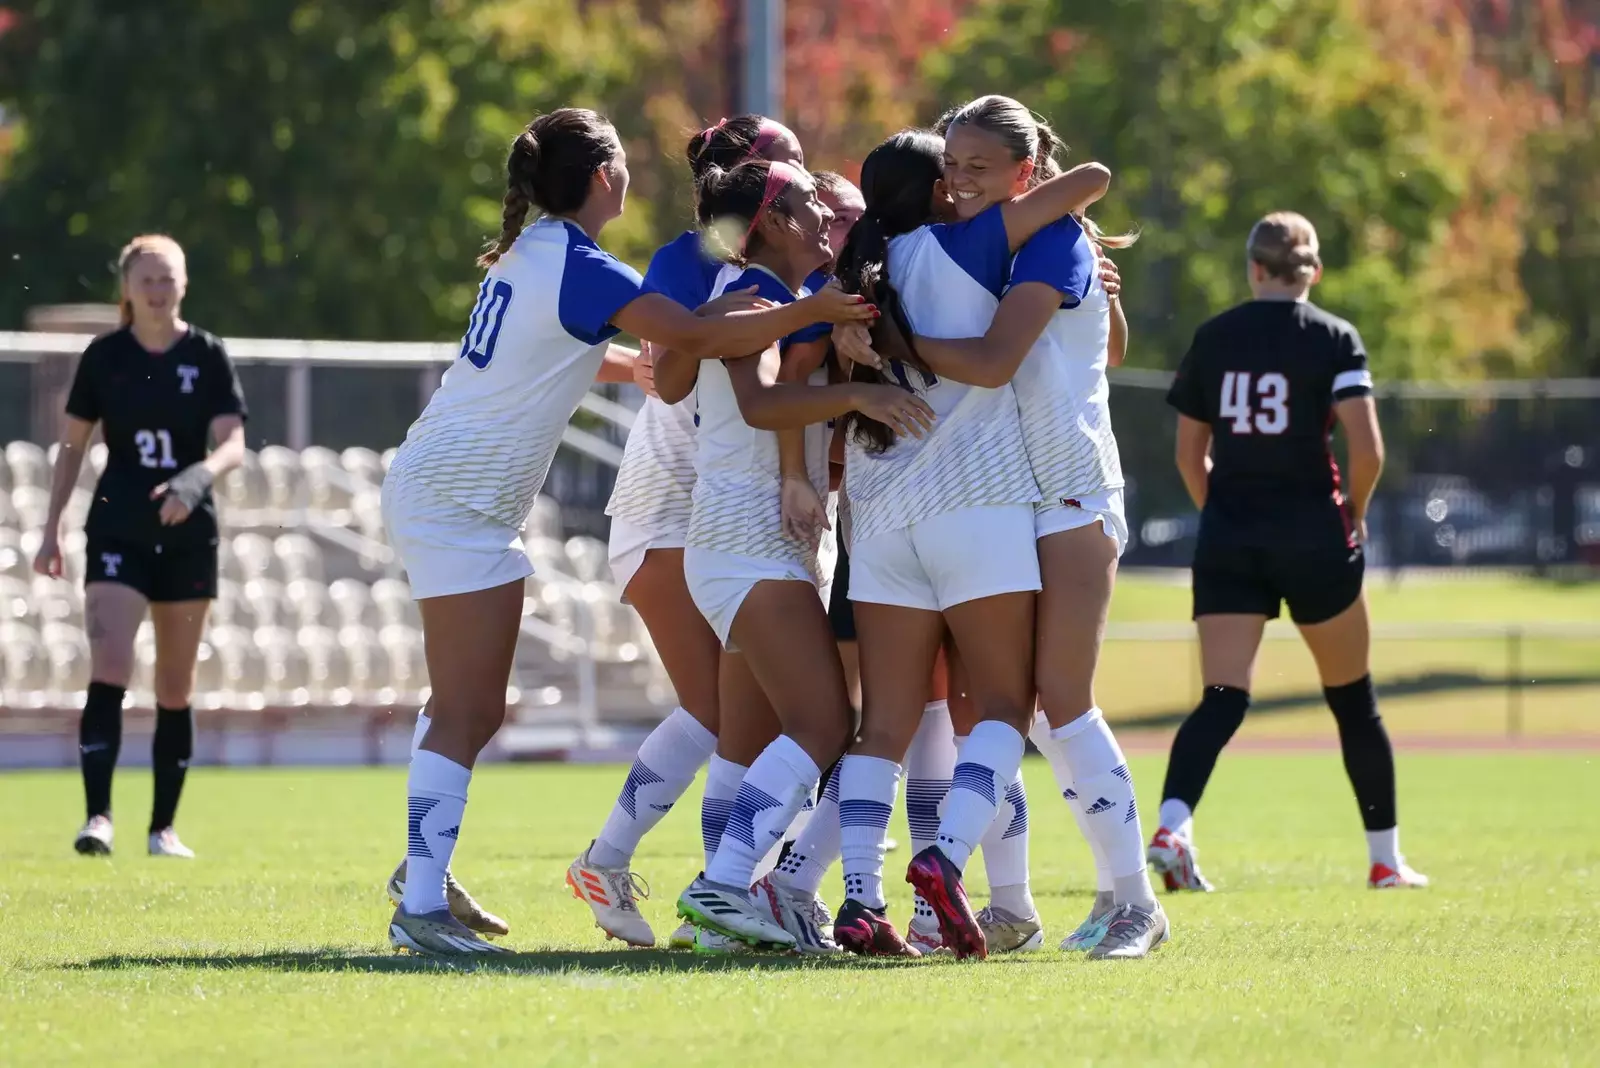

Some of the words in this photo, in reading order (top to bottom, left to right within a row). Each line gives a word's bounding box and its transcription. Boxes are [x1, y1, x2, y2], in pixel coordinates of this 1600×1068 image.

[177, 365, 199, 393] T
[1219, 371, 1289, 435] 43
[134, 429, 177, 468] 21
[101, 553, 122, 576] T
[1085, 801, 1117, 815] adidas
